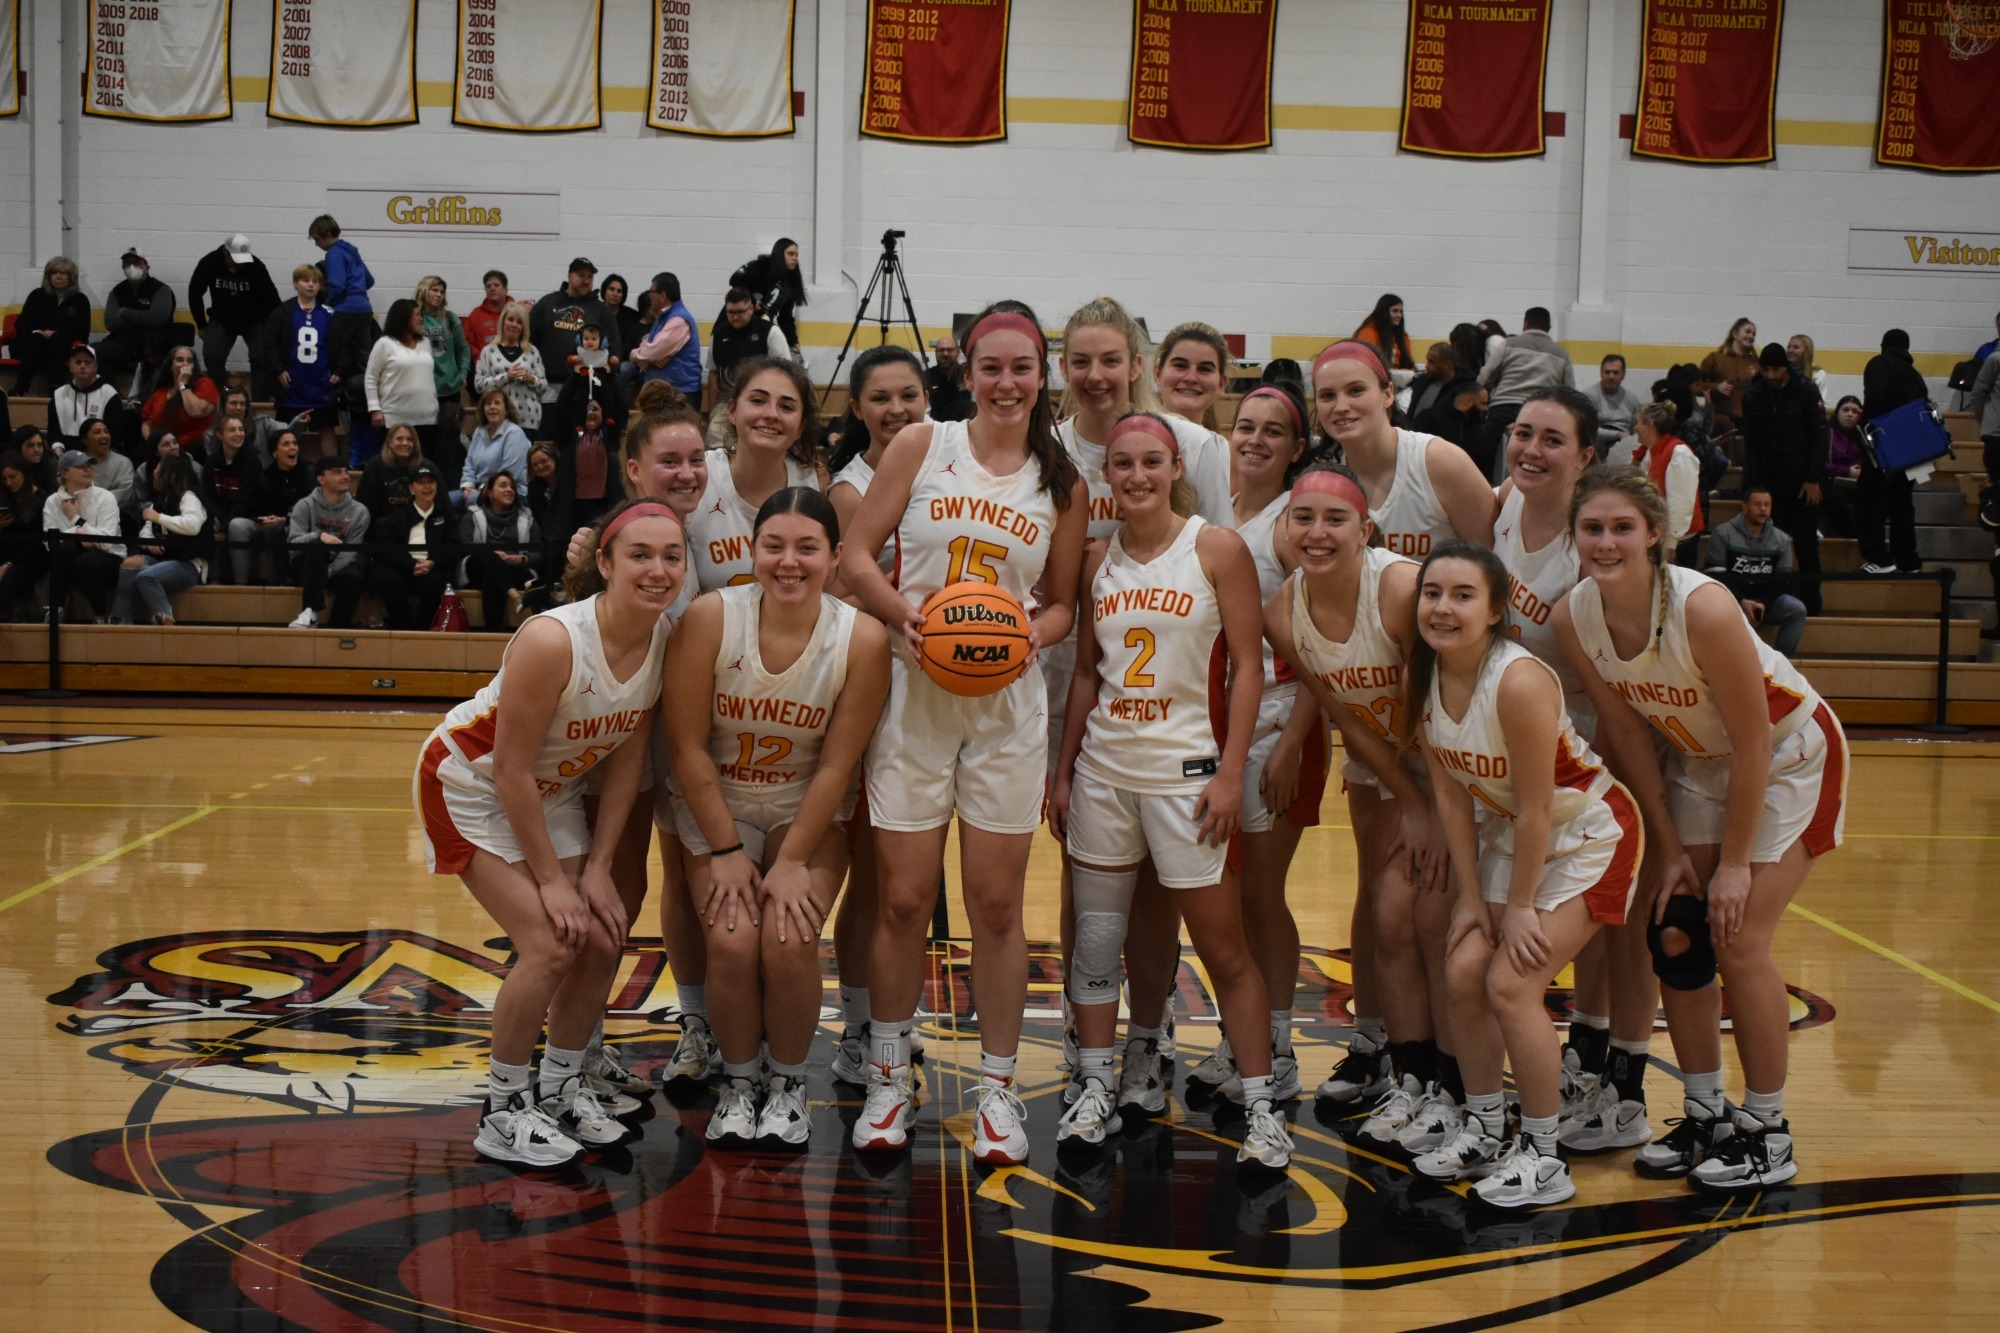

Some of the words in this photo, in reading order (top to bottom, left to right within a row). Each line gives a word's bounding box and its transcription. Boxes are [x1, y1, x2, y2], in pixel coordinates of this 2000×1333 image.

[99, 4, 125, 18] 2009
[130, 7, 158, 20] 2018
[663, 0, 690, 16] 2000
[1186, 0, 1263, 14] TOURNAMENT
[1424, 4, 1453, 19] NCAA
[1459, 6, 1538, 22] TOURNAMENT
[1907, 3, 1942, 16] FIELD
[284, 9, 310, 23] 2001
[469, 14, 495, 28] 2004
[878, 6, 904, 21] 1999
[908, 9, 938, 24] 2012
[1143, 14, 1170, 30] 2004
[1657, 11, 1685, 26] NCAA
[1692, 14, 1767, 30] TOURNAMENT
[98, 23, 124, 37] 2010
[284, 26, 310, 40] 2007
[664, 18, 689, 33] 2001
[877, 24, 904, 38] 2000
[908, 26, 938, 41] 2017
[1418, 22, 1445, 38] 2000
[1898, 20, 1926, 35] NCAA
[468, 32, 495, 46] 2005
[664, 36, 689, 50] 2003
[1142, 32, 1170, 47] 2005
[1651, 29, 1677, 44] 2008
[1681, 32, 1708, 46] 2017
[97, 39, 124, 55] 2011
[283, 44, 310, 59] 2008
[876, 42, 903, 57] 2001
[1417, 40, 1444, 55] 2001
[1893, 39, 1920, 53] 1999
[468, 50, 494, 64] 2009
[663, 54, 688, 68] 2006
[1142, 50, 1170, 65] 2009
[1650, 46, 1677, 61] 2009
[1680, 50, 1706, 64] 2018
[97, 57, 124, 73] 2013
[282, 62, 309, 76] 2019
[874, 59, 902, 75] 2003
[1415, 58, 1444, 73] 2006
[1649, 64, 1676, 79] 2010
[98, 74, 124, 90] 2014
[467, 67, 493, 82] 2016
[662, 72, 688, 86] 2007
[1141, 68, 1168, 82] 2011
[873, 77, 901, 93] 2004
[1414, 75, 1444, 90] 2007
[466, 84, 494, 99] 2019
[660, 89, 688, 104] 2012
[1139, 85, 1168, 100] 2016
[96, 92, 123, 107] 2015
[872, 95, 900, 110] 2006
[1412, 93, 1442, 108] 2008
[1647, 99, 1674, 114] 2013
[659, 106, 687, 122] 2017
[1138, 103, 1167, 118] 2019
[1889, 107, 1914, 122] 2014
[871, 112, 899, 128] 2007
[1645, 115, 1672, 131] 2015
[1888, 125, 1915, 139] 2017
[1644, 133, 1670, 147] 2016
[1886, 142, 1914, 156] 2018
[387, 196, 501, 226] Griffins
[297, 326, 318, 363] 8
[930, 496, 1039, 546] GWYNEDD
[946, 535, 1009, 588] 15
[1731, 557, 1772, 574] Eagles
[1095, 588, 1194, 622] GWYNEDD
[943, 604, 1017, 628] Wilson
[952, 644, 1009, 662] NCAA
[1124, 627, 1155, 687] 2
[1314, 665, 1398, 693] WYNEDD
[716, 693, 826, 729] GWYNEDD
[1110, 697, 1172, 721] MERCY
[567, 709, 651, 740] GWYNE
[736, 732, 793, 765] 12
[720, 764, 797, 784] MERCY
